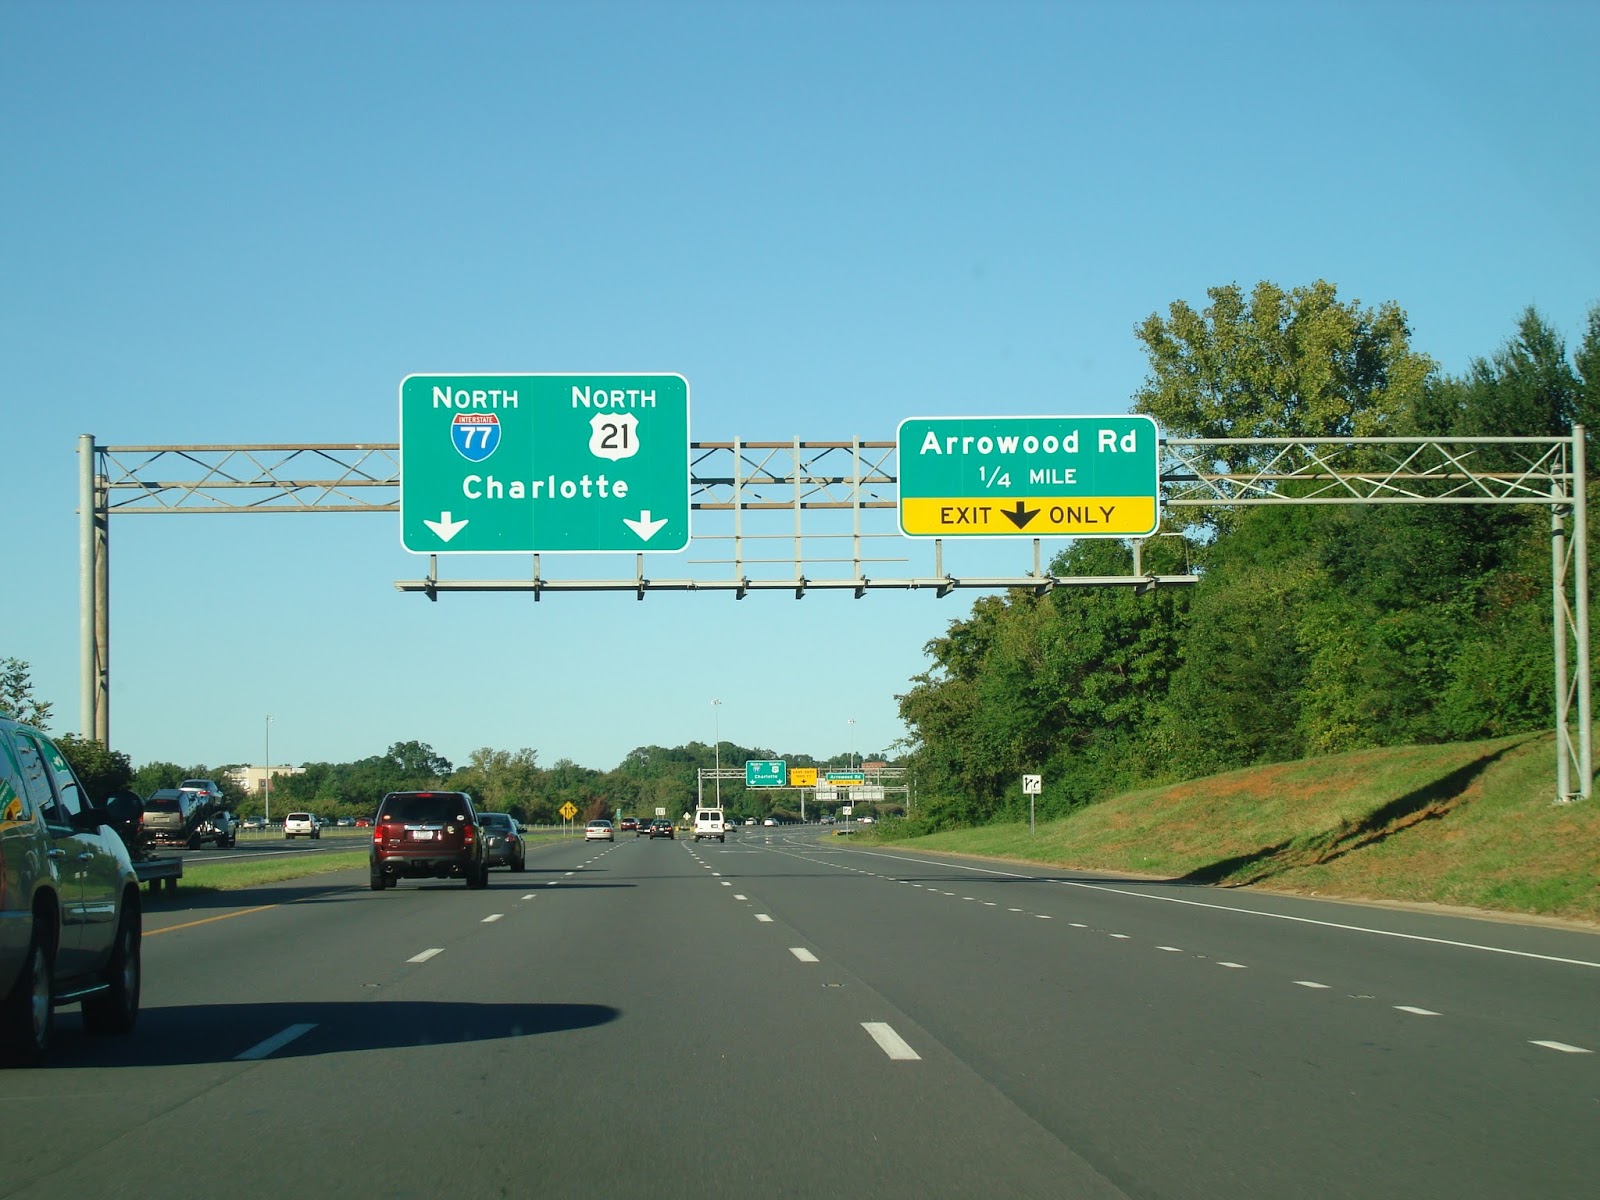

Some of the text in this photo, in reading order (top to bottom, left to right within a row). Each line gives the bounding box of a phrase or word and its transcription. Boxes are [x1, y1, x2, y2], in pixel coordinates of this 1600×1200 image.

[433, 386, 518, 408] NORTH
[572, 385, 656, 408] NORTH
[460, 426, 492, 449] 77
[600, 423, 628, 449] 21
[919, 429, 1137, 455] Arrowood Rd
[462, 474, 629, 499] Charlotte
[1029, 468, 1077, 485] MILE
[940, 505, 1115, 524] EXIT ONLY
